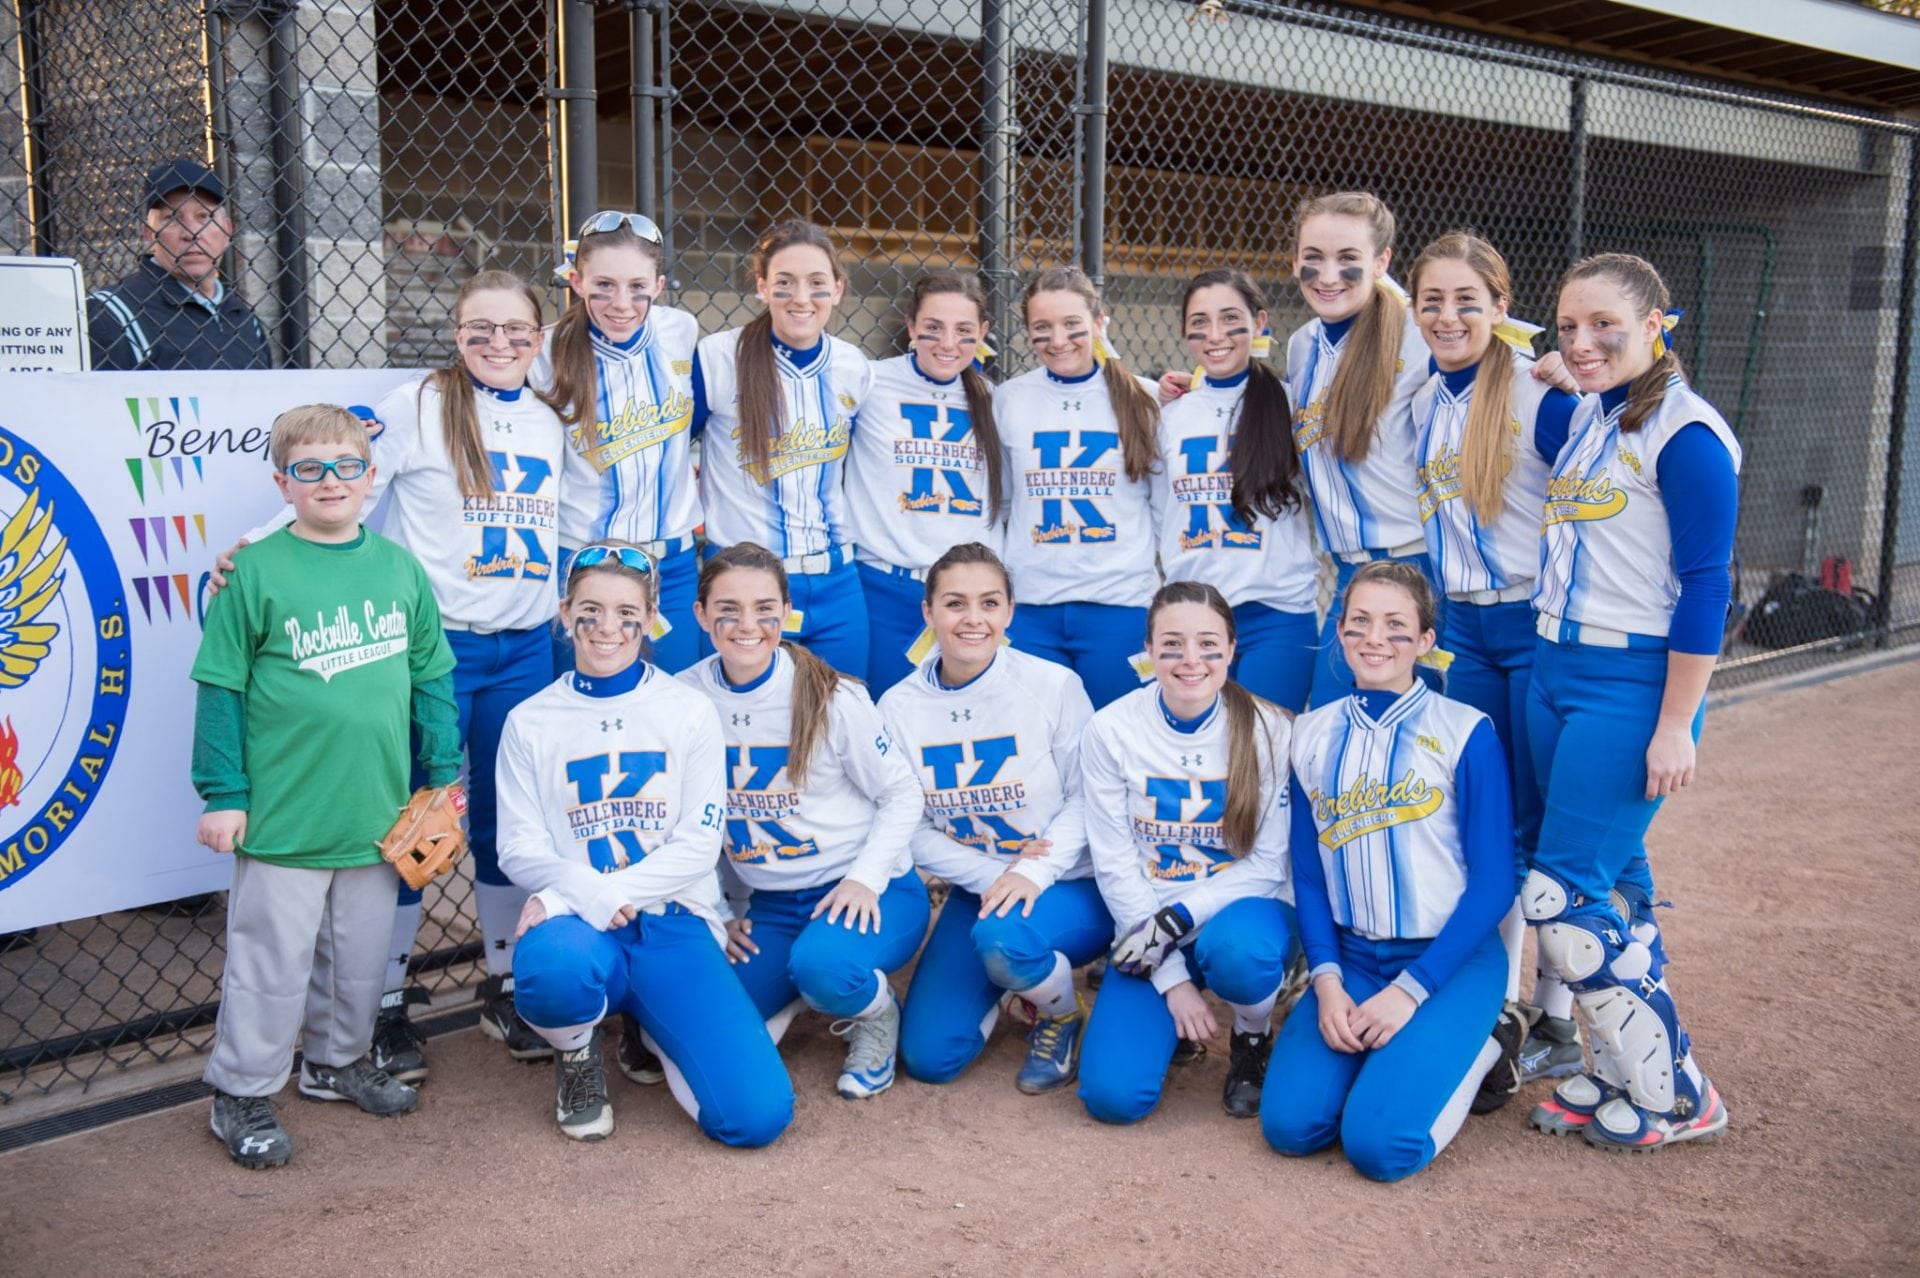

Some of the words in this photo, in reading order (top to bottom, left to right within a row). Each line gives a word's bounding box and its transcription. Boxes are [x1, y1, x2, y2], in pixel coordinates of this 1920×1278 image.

[0, 327, 21, 337] NG
[25, 327, 42, 337] OF
[46, 327, 73, 337] ANY
[50, 345, 64, 354] IN
[894, 440, 985, 463] KELLENBERG
[895, 455, 983, 471] SOFTBALL
[1025, 471, 1116, 487] KELLENBERG
[1028, 486, 1113, 497] SOFTBALL
[462, 494, 555, 519] KELLENBERG
[464, 512, 554, 529] SOFTBALL
[284, 605, 364, 661] Rockville
[320, 656, 355, 672] LITTLE
[358, 642, 392, 661] LEAGUE
[567, 801, 667, 829] KELLENBERG
[574, 818, 665, 840] SOFTBALL
